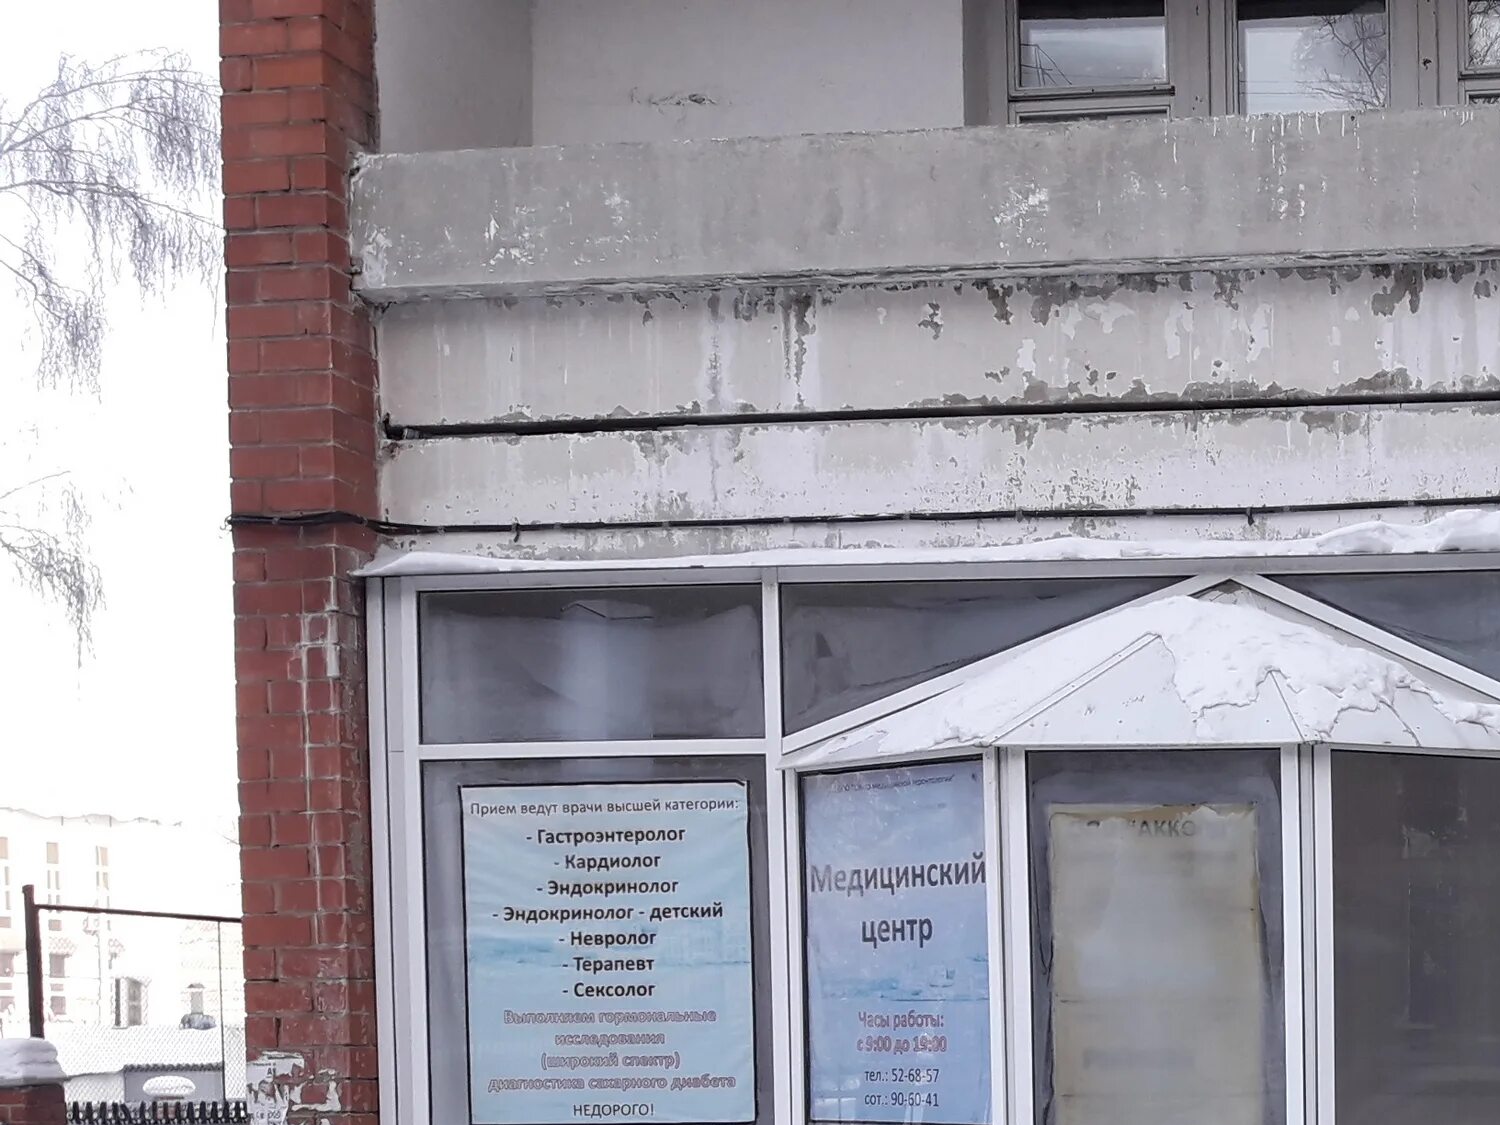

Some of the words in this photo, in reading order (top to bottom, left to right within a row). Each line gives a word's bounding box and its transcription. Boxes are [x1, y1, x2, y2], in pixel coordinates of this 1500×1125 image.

[470, 802, 517, 817] Прием
[521, 803, 557, 816] ведут
[562, 803, 602, 815] врачи
[607, 799, 661, 813] высшей
[665, 799, 739, 814] категории:
[537, 827, 685, 846] Гастроэнтеролог
[565, 854, 661, 871] Кардиолог
[810, 850, 986, 897] Медицинский
[547, 880, 679, 897] Эндокринолог
[503, 906, 634, 923] Эндокринолог
[650, 902, 723, 922] детский
[570, 931, 656, 948] Невролог
[861, 917, 934, 948] центр
[574, 957, 654, 973] Терапевт
[573, 982, 655, 997] Сексолог
[504, 1010, 595, 1024] Выполняем
[599, 1009, 717, 1026] гормональные
[858, 1011, 890, 1028] Часы
[893, 1009, 944, 1031] работы:
[555, 1033, 665, 1047] исследования
[857, 1038, 864, 1051] с
[893, 1039, 910, 1055] до
[541, 1052, 619, 1070] (широкий
[622, 1051, 681, 1070] спектр)
[488, 1077, 585, 1092] диагностика
[588, 1075, 667, 1091] сахарного
[671, 1073, 736, 1090] диабета
[864, 1071, 888, 1082] тел.:
[891, 1068, 939, 1083] 52-68-57
[864, 1094, 888, 1105] сот.:
[891, 1091, 939, 1107] 90-60-41
[573, 1103, 655, 1118] НЕДОРОГО!
